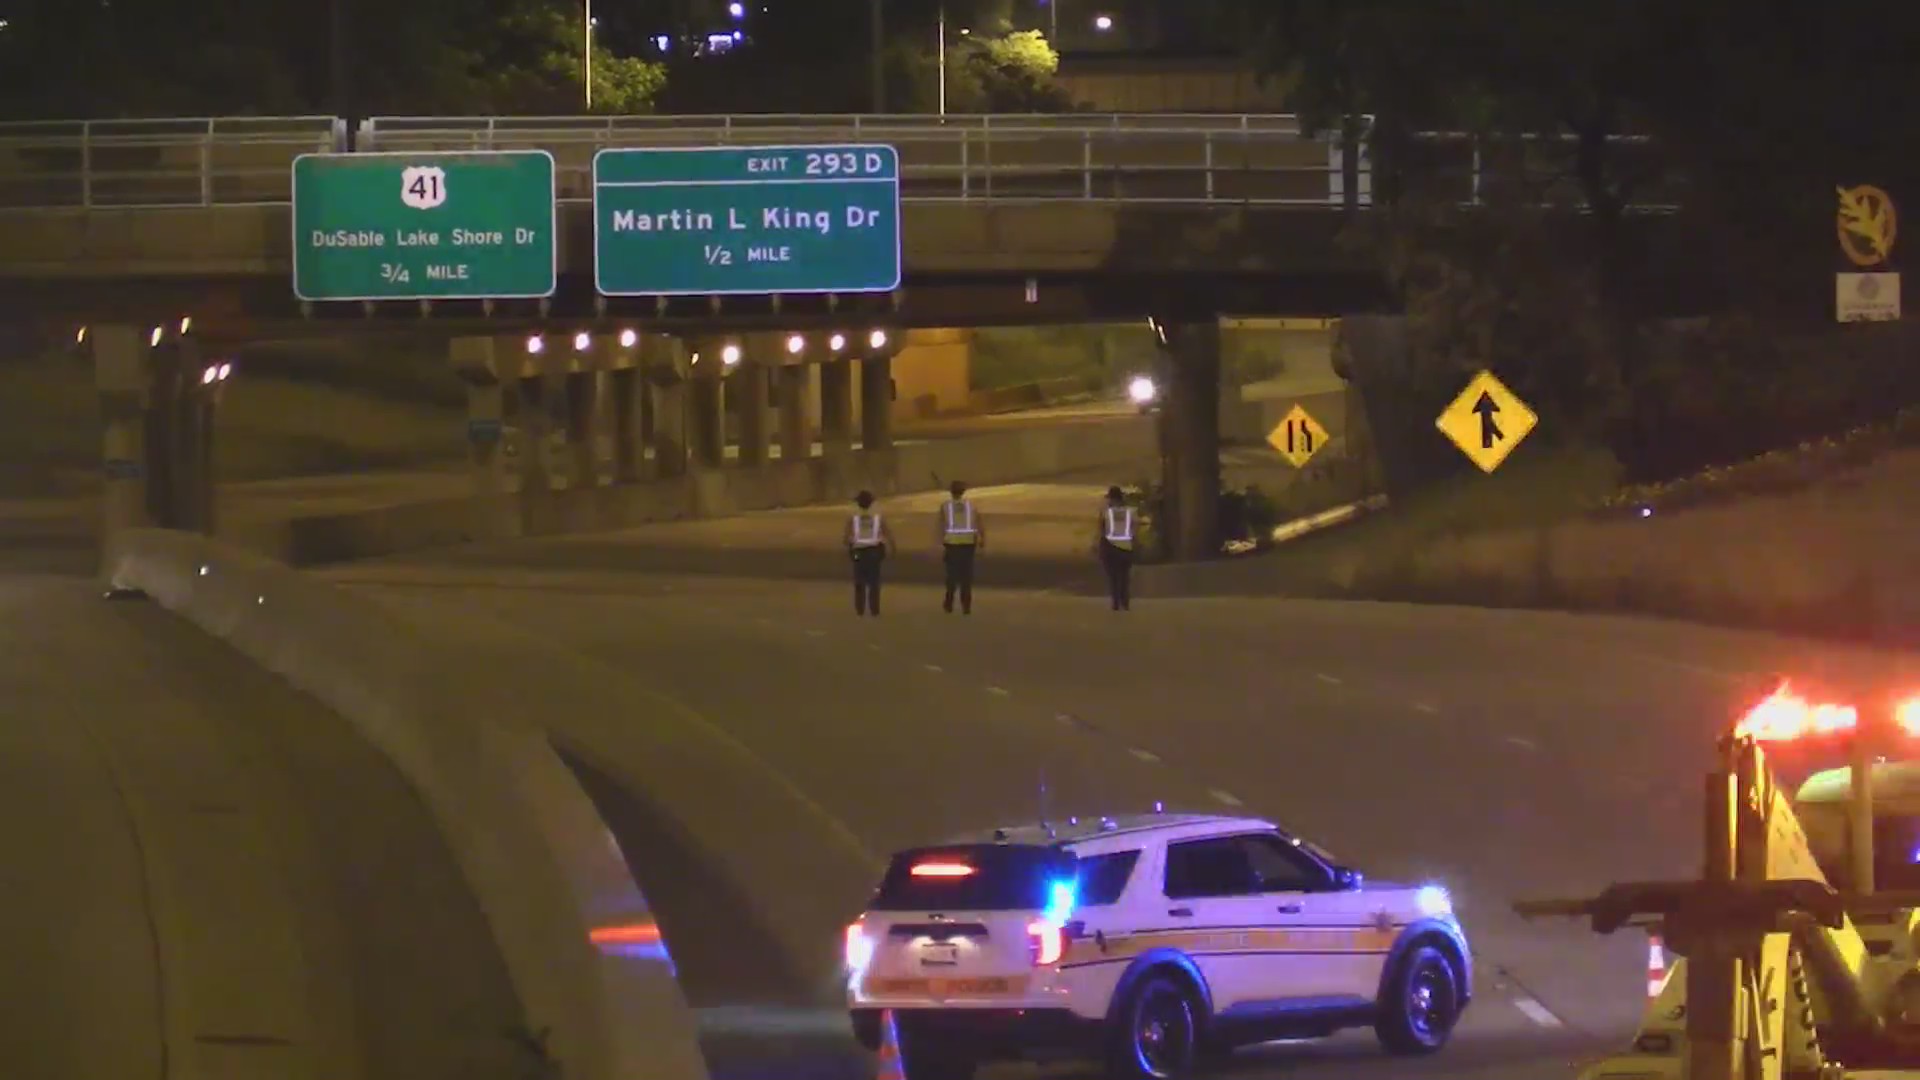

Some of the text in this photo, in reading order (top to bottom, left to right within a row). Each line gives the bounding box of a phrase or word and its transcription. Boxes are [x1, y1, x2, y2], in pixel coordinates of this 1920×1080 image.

[747, 157, 788, 172] EXIT
[408, 175, 438, 200] 41
[612, 206, 880, 234] Martin L King Dr
[312, 228, 535, 247] DuSable Lake Shore Dr
[748, 247, 791, 262] MILE
[426, 264, 469, 280] MILE
